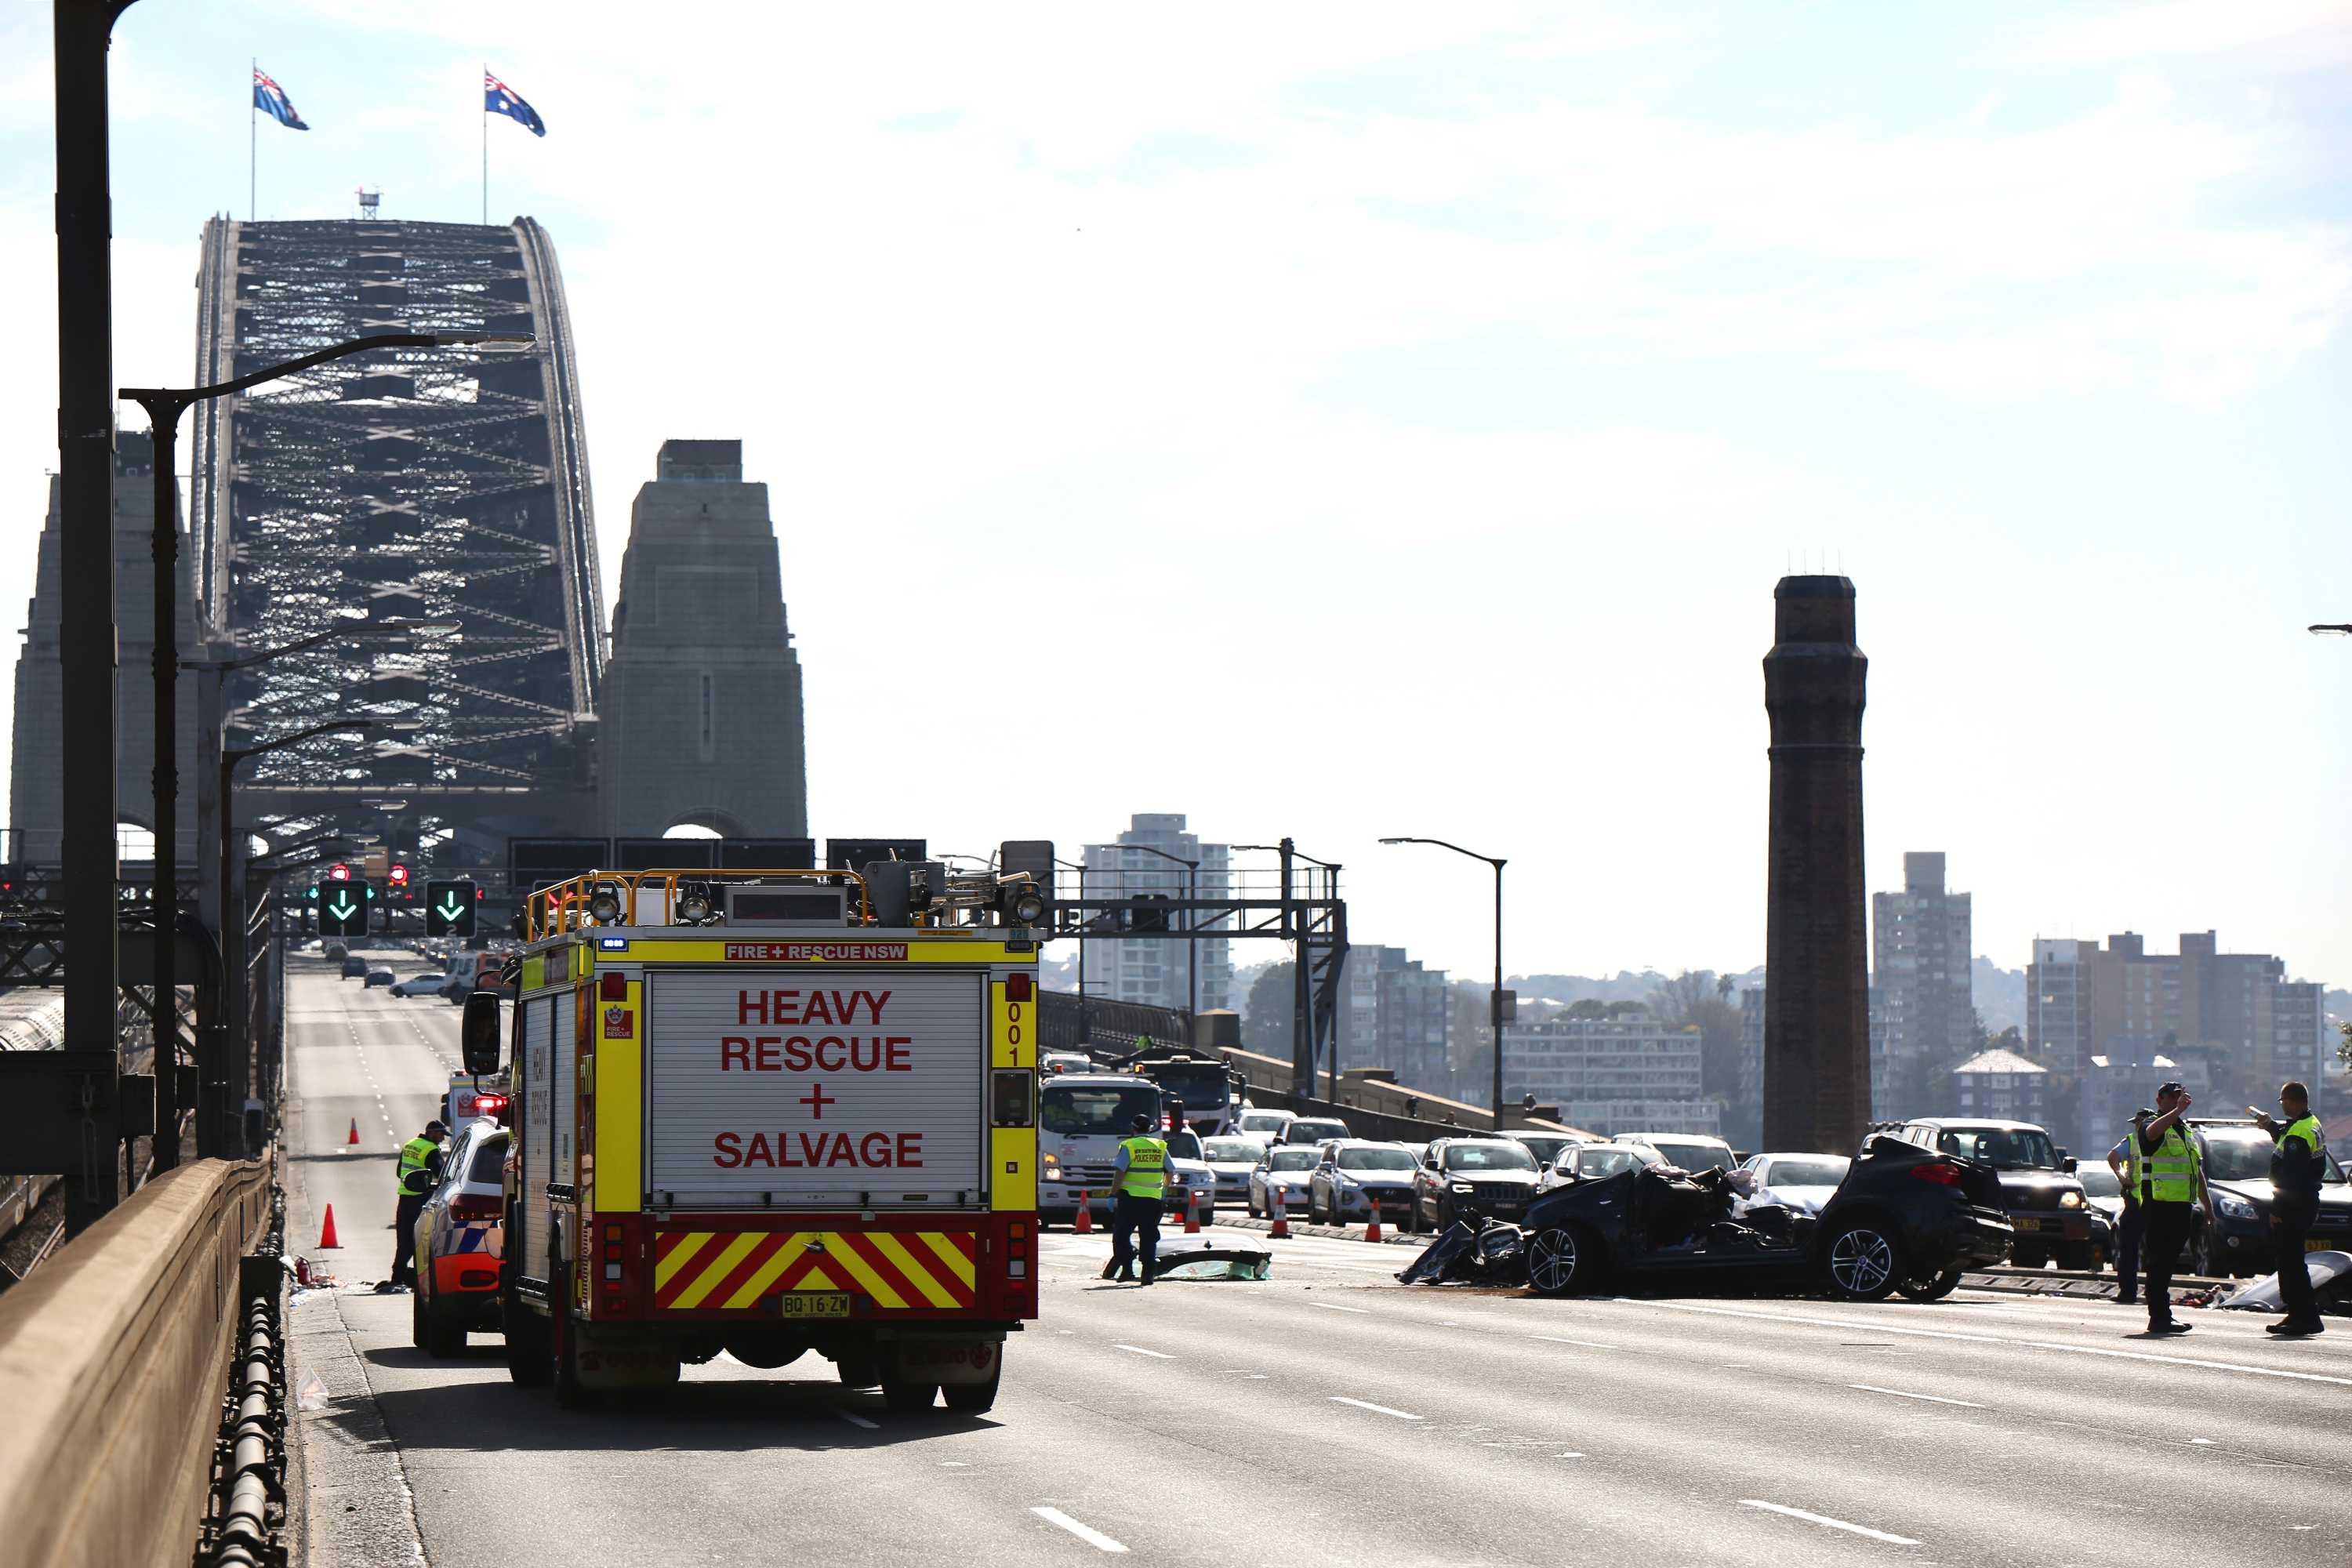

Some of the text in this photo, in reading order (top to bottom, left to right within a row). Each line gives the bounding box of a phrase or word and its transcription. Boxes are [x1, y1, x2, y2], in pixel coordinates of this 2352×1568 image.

[446, 924, 457, 937] 2
[727, 946, 768, 958] FIRE
[789, 946, 861, 958] RESCUE
[865, 946, 905, 958] NSW
[739, 990, 892, 1025] HEAVY
[721, 1036, 912, 1072] RESCUE
[713, 1132, 923, 1167] SALVAGE
